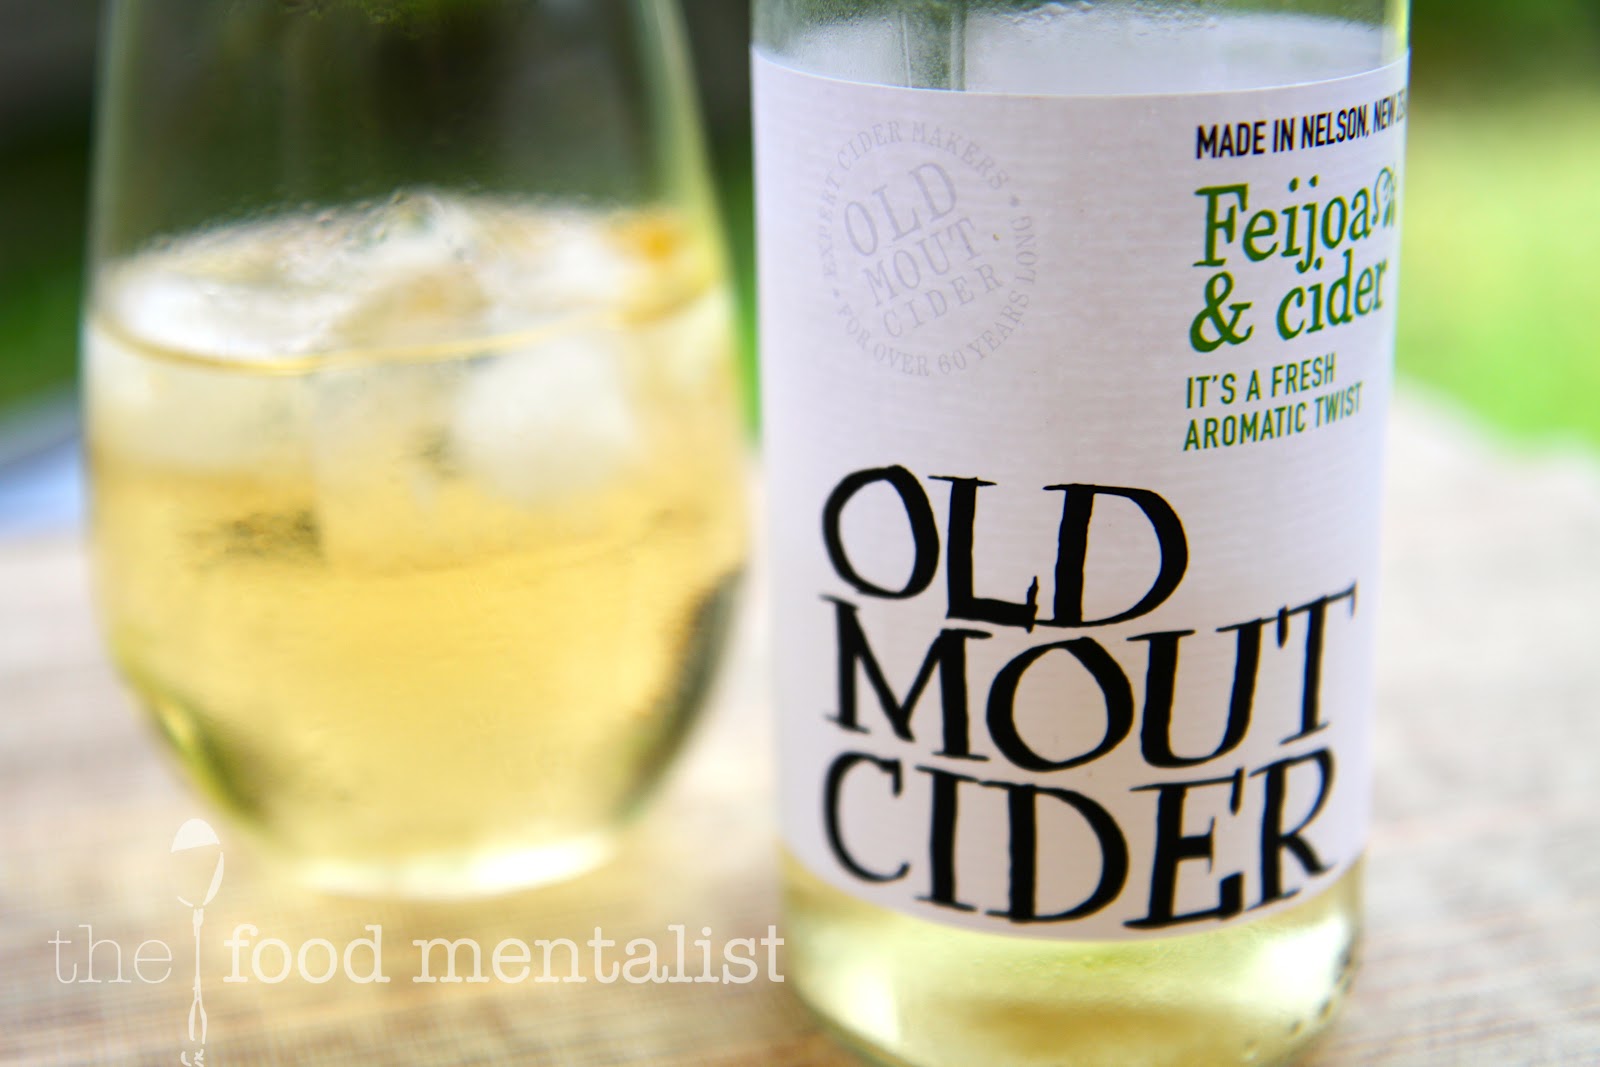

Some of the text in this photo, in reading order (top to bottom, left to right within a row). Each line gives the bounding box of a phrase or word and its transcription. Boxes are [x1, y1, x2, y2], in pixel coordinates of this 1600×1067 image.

[1196, 120, 1266, 159] MADE
[1273, 117, 1295, 153] IN
[1301, 104, 1370, 149] NELSON,
[1373, 96, 1397, 132] NEW
[817, 121, 1009, 278] EXPERT CIDER MAKERS
[844, 162, 957, 256] OLD
[1193, 175, 1371, 274] Feijoa
[837, 215, 1039, 377] FOR OVER 60 YEARS LONG
[863, 217, 982, 306] MOUT
[883, 264, 1003, 338] CIDER
[1189, 248, 1388, 353] & cider
[1183, 381, 1363, 451] AROMATIC TWIST
[1186, 353, 1336, 409] IT'S A FRESH
[822, 464, 1190, 630] OLD
[819, 581, 1357, 772] MOUT
[822, 747, 1337, 930] CIDER
